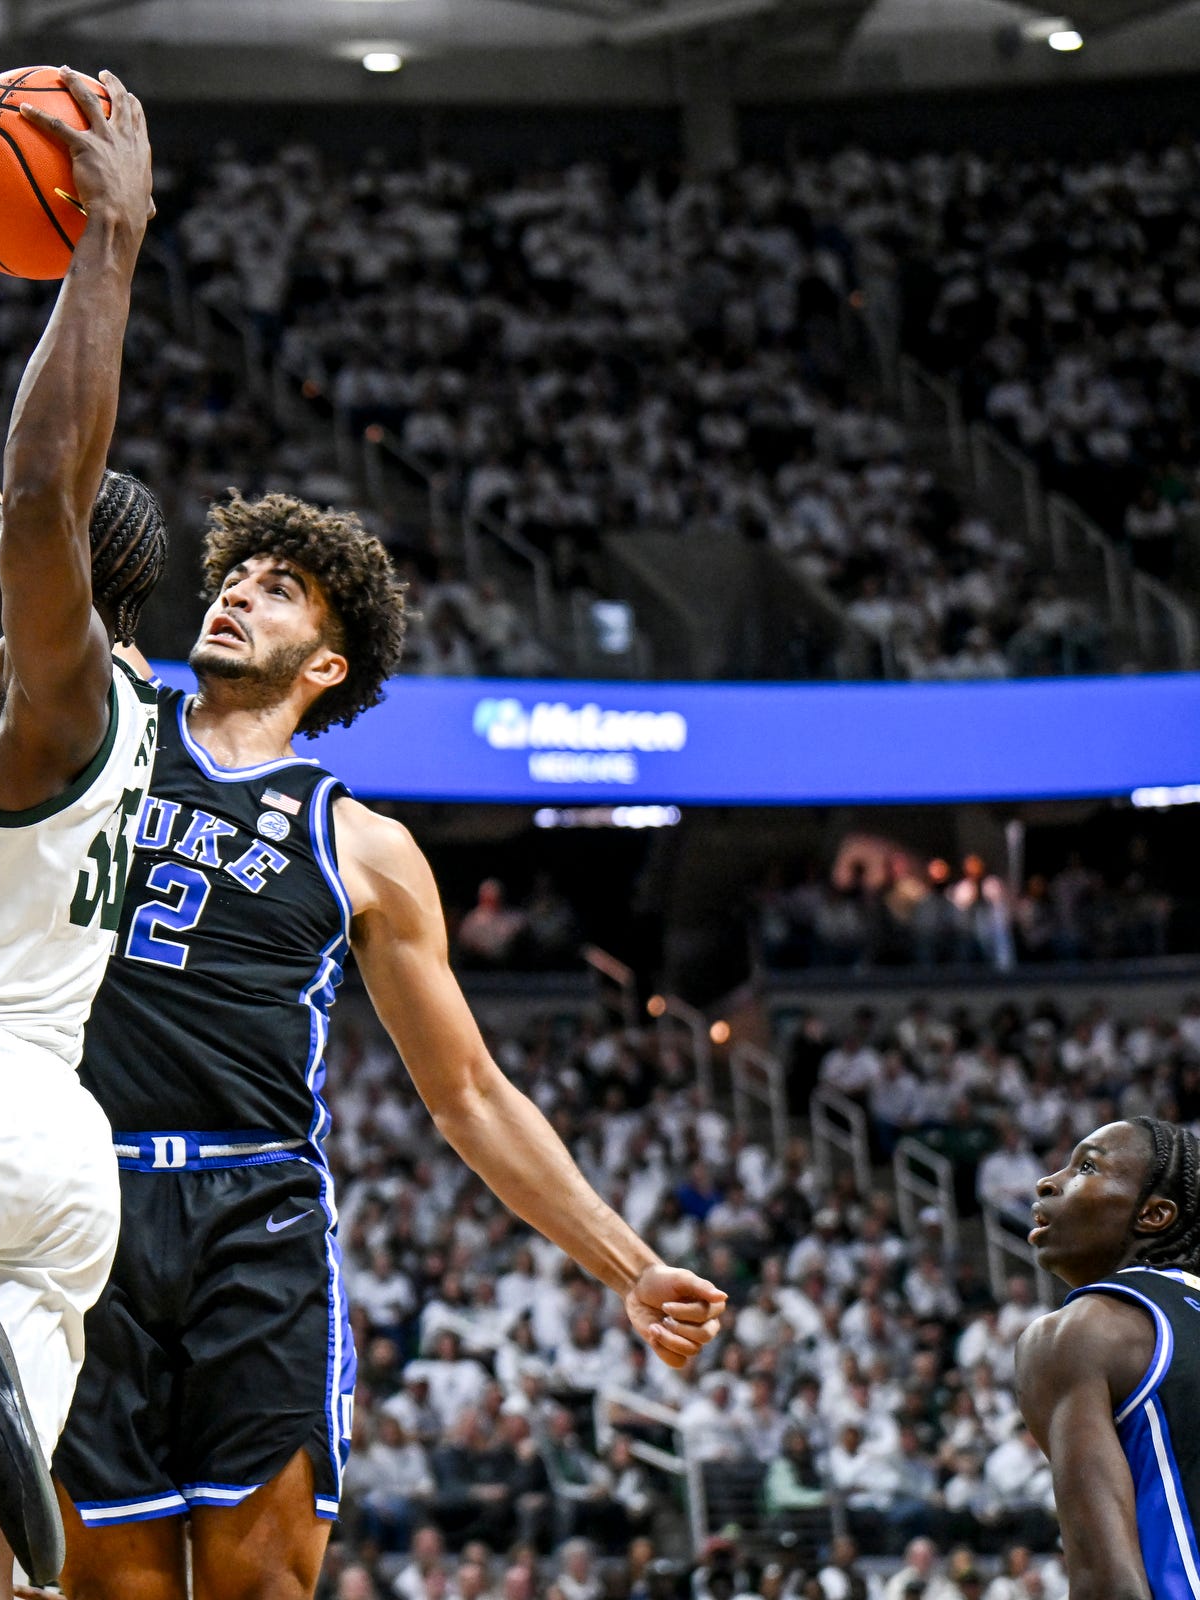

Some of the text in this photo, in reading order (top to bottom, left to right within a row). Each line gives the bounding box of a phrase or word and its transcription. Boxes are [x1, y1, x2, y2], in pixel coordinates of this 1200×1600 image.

[530, 703, 686, 751] McLaren
[134, 796, 290, 893] UKE
[151, 1136, 187, 1168] D
